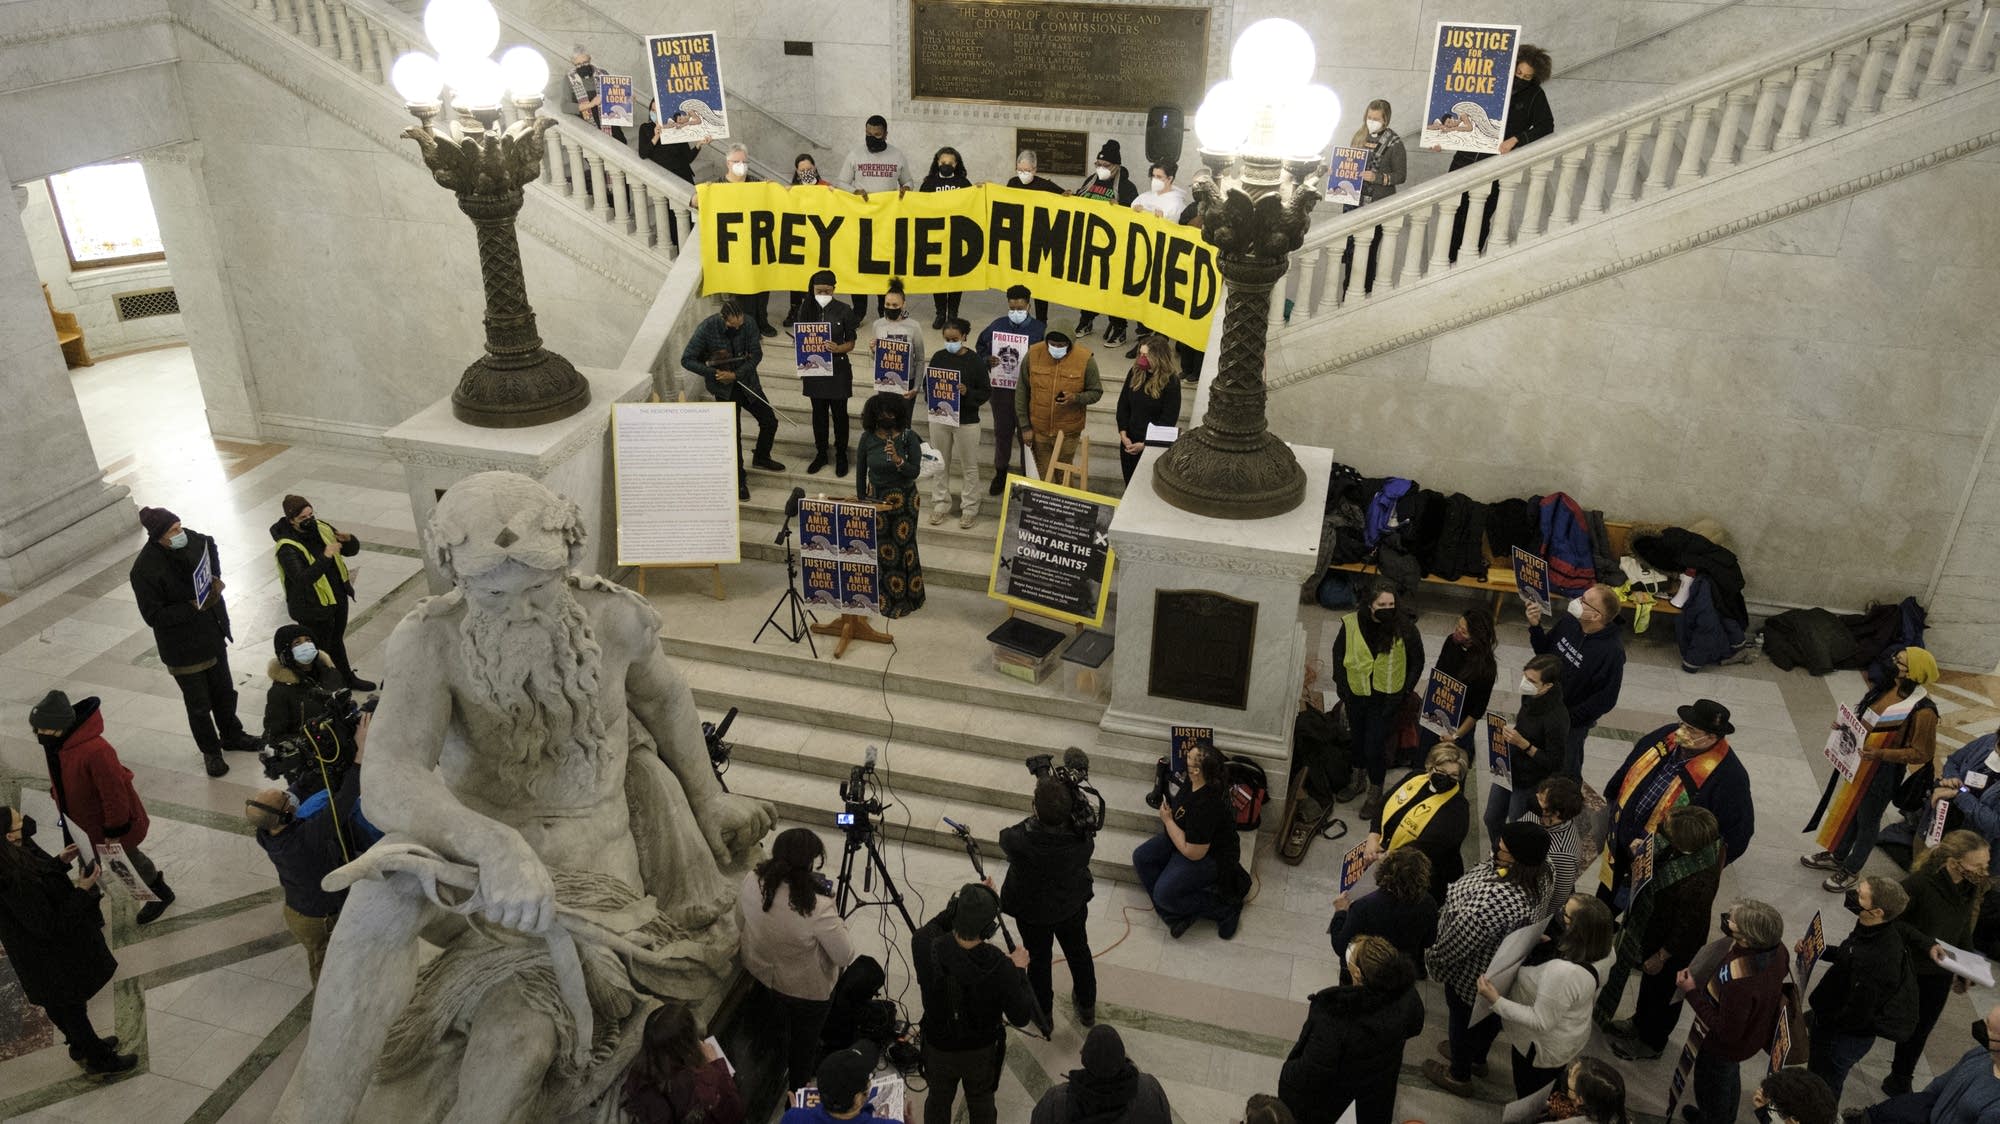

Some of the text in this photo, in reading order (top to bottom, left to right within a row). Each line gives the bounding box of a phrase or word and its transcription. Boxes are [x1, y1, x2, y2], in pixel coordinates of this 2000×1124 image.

[960, 8, 977, 18] THE
[984, 8, 1020, 19] BOARD
[1026, 10, 1040, 20] OF
[1139, 16, 1160, 24] AND
[976, 20, 1140, 35] CITY HALL COMMISSIONERS
[1445, 30, 1510, 51] JUSTICE
[656, 38, 710, 56] JUSTICE
[1468, 49, 1482, 58] FOR
[670, 61, 704, 78] AMIR
[1452, 57, 1494, 76] AMIR
[603, 77, 630, 85] JUSTICE
[668, 76, 710, 93] LOCKE
[1445, 74, 1496, 94] LOCKE
[608, 88, 625, 96] AMIR
[606, 95, 628, 104] LOCKE
[1335, 148, 1367, 160] JUSTICE
[1339, 162, 1358, 170] AMIR
[1335, 169, 1359, 180] LOCKE
[716, 200, 1216, 320] FREY LIED AMIR DIED
[797, 324, 828, 333] JUSTICE
[804, 336, 823, 345] AMIR
[994, 333, 1027, 343] PROTECT?
[802, 344, 827, 353] LOCKE
[878, 340, 909, 353] JUSTICE
[883, 353, 903, 363] AMIR
[881, 360, 904, 371] LOCKE
[929, 369, 958, 381] JUSTICE
[935, 382, 953, 392] AMIR
[998, 379, 1016, 390] SERV
[932, 390, 955, 401] LOCKE
[802, 501, 834, 514] JUSTICE
[840, 505, 873, 518] JUSTICE
[808, 515, 829, 526] AMIR
[846, 519, 867, 530] AMIR
[806, 523, 831, 535] LOCKE
[844, 528, 870, 539] LOCKE
[1018, 530, 1048, 548] WHAT
[1049, 540, 1070, 552] ARE
[1072, 544, 1092, 557] THE
[804, 558, 836, 570] JUSTICE
[1017, 546, 1088, 572] COMPLAINTS?
[1515, 549, 1545, 571] JUSTICE
[842, 562, 874, 574] JUSTICE
[1521, 564, 1540, 580] AMIR
[810, 571, 831, 581] AMIR
[849, 576, 870, 585] AMIR
[1520, 571, 1544, 590] LOCKE
[809, 579, 834, 589] LOCKE
[847, 584, 872, 594] LOCKE
[1432, 670, 1465, 695] JUSTICE
[1436, 687, 1456, 705] AMIR
[1432, 694, 1456, 715] LOCKE
[1840, 704, 1867, 736] PROTECT?
[1174, 728, 1211, 738] JUSTICE
[1829, 754, 1854, 780] SERVE?
